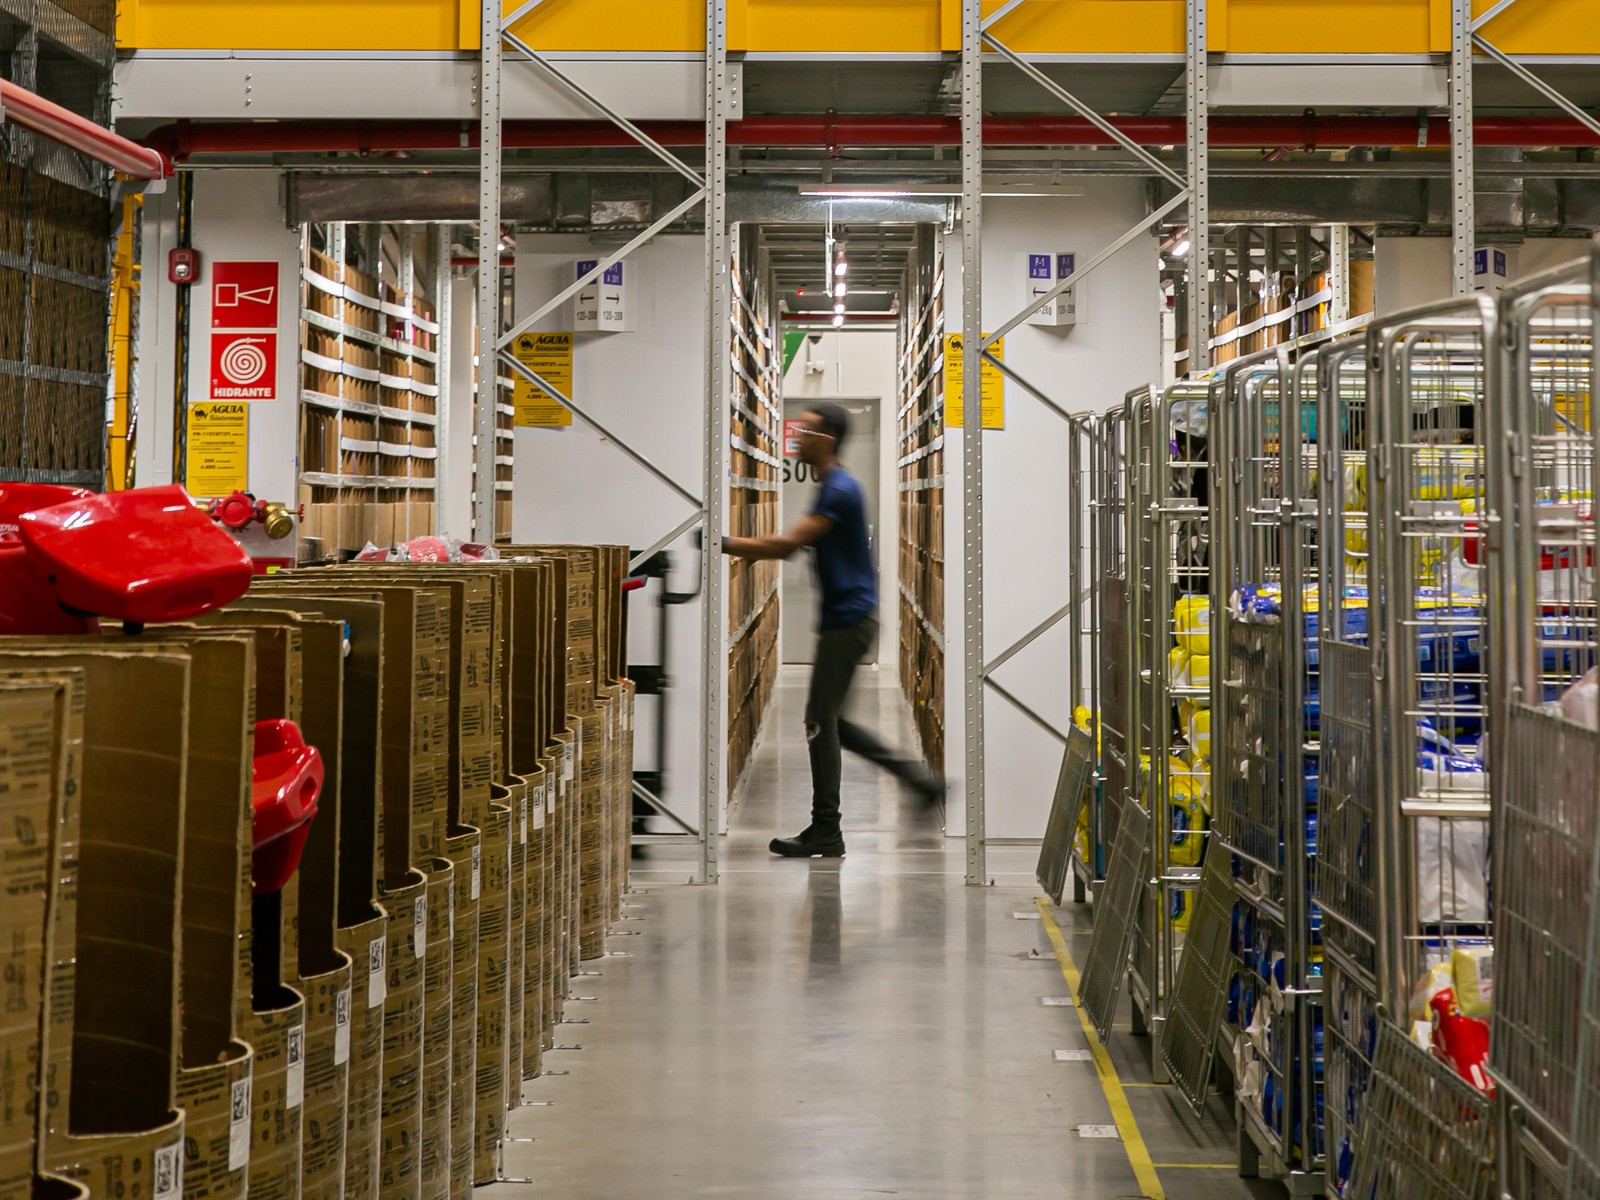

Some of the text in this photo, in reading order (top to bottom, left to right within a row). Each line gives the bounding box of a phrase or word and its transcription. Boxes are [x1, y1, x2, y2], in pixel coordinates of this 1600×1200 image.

[1035, 256, 1045, 267] P-1
[1032, 268, 1037, 276] A
[536, 334, 569, 345] ÁGUIA
[213, 387, 272, 398] HIDRANTE
[210, 404, 244, 414] ÁGUIA
